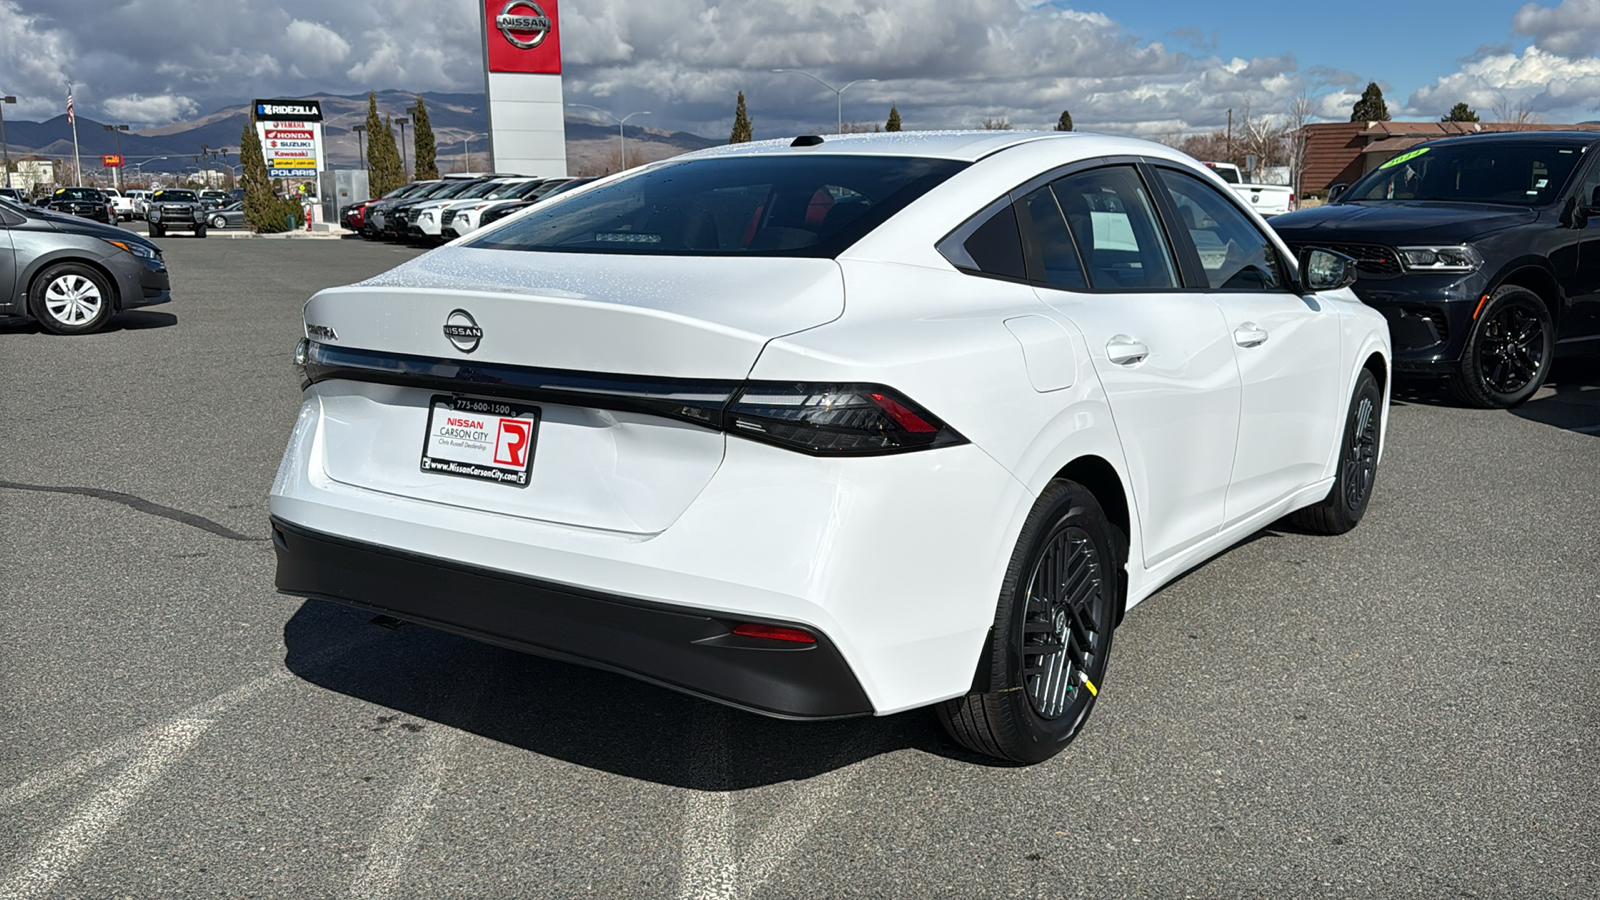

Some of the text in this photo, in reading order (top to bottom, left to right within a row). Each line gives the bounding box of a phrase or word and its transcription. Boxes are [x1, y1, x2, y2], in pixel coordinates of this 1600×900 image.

[502, 17, 547, 28] NISSAN
[272, 105, 319, 115] RIDEZILLA
[443, 325, 482, 338] NISSAN
[456, 400, 511, 414] 775-600-1500
[446, 417, 485, 430] NISSAN
[439, 426, 489, 441] CARSON CITY
[438, 437, 487, 452] Chris Russell Dealership
[501, 422, 526, 465] R
[430, 461, 518, 482] www.NissanCarsonCity.com
